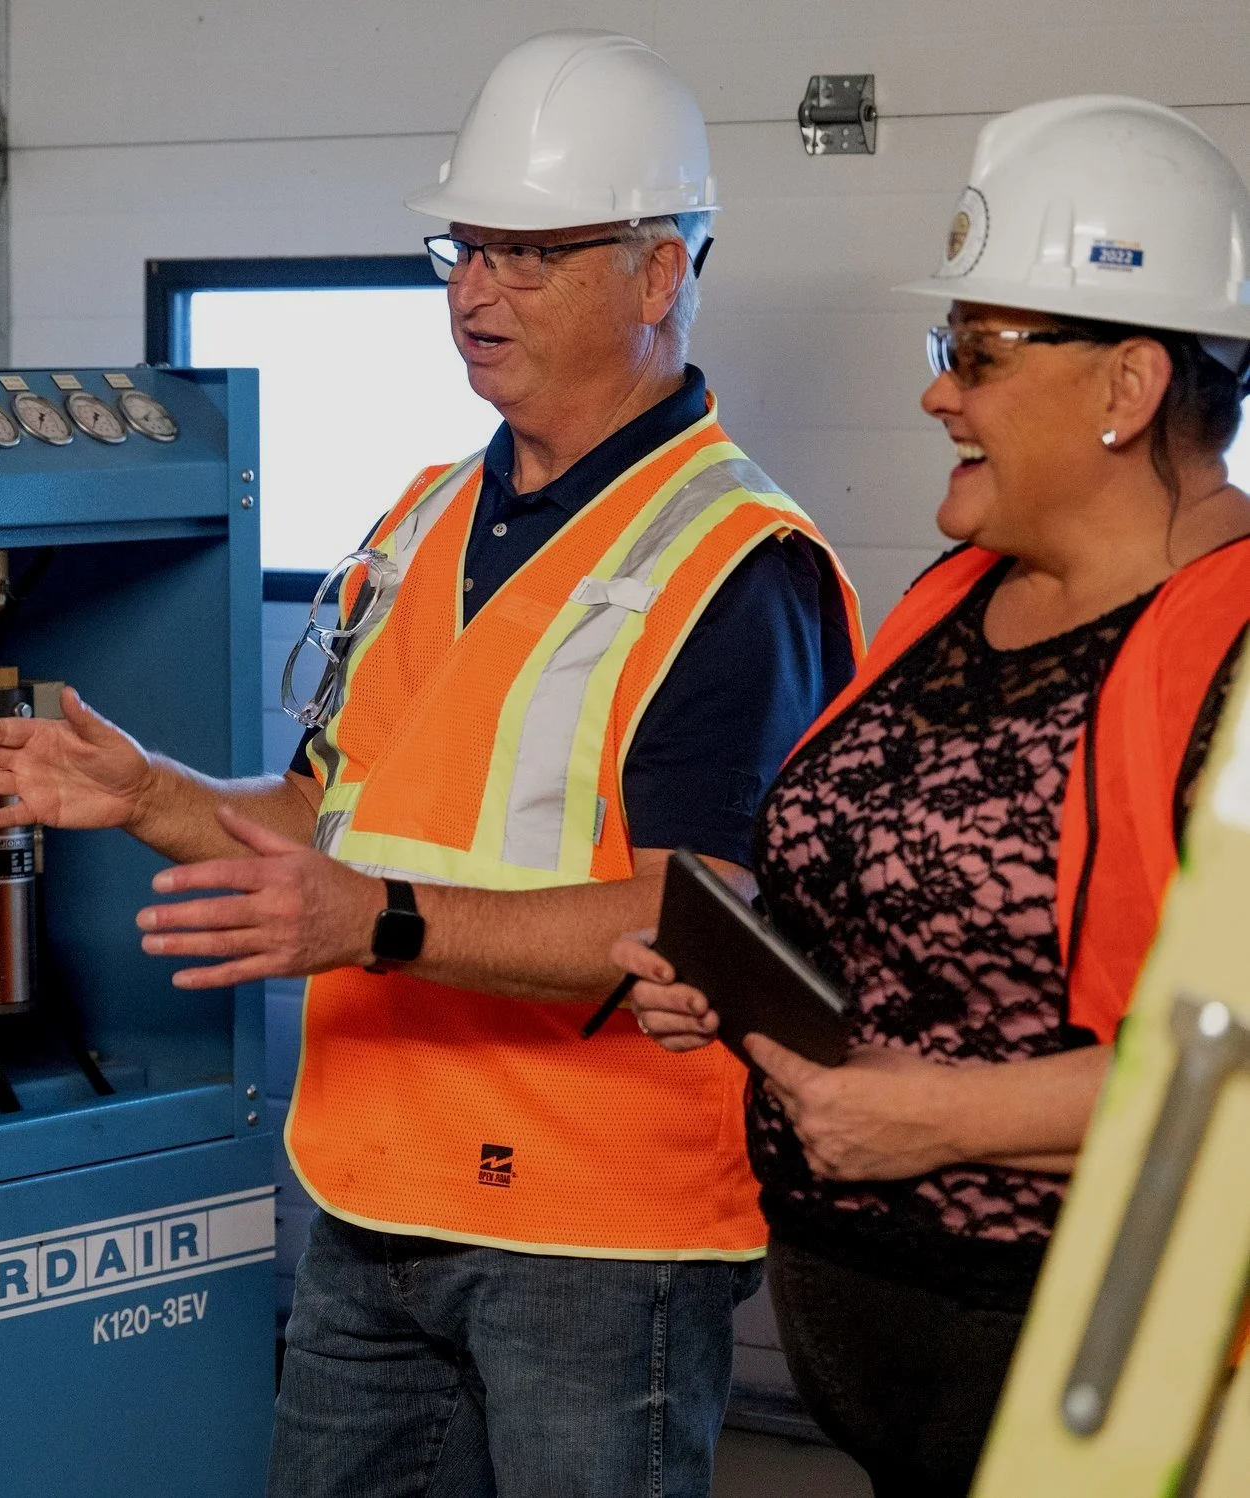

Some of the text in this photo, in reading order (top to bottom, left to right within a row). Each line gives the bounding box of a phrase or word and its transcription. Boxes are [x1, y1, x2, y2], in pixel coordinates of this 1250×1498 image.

[1098, 247, 1134, 263] 2022
[478, 1170, 511, 1185] OPEN ROAD
[92, 1291, 208, 1345] K120-3EV
